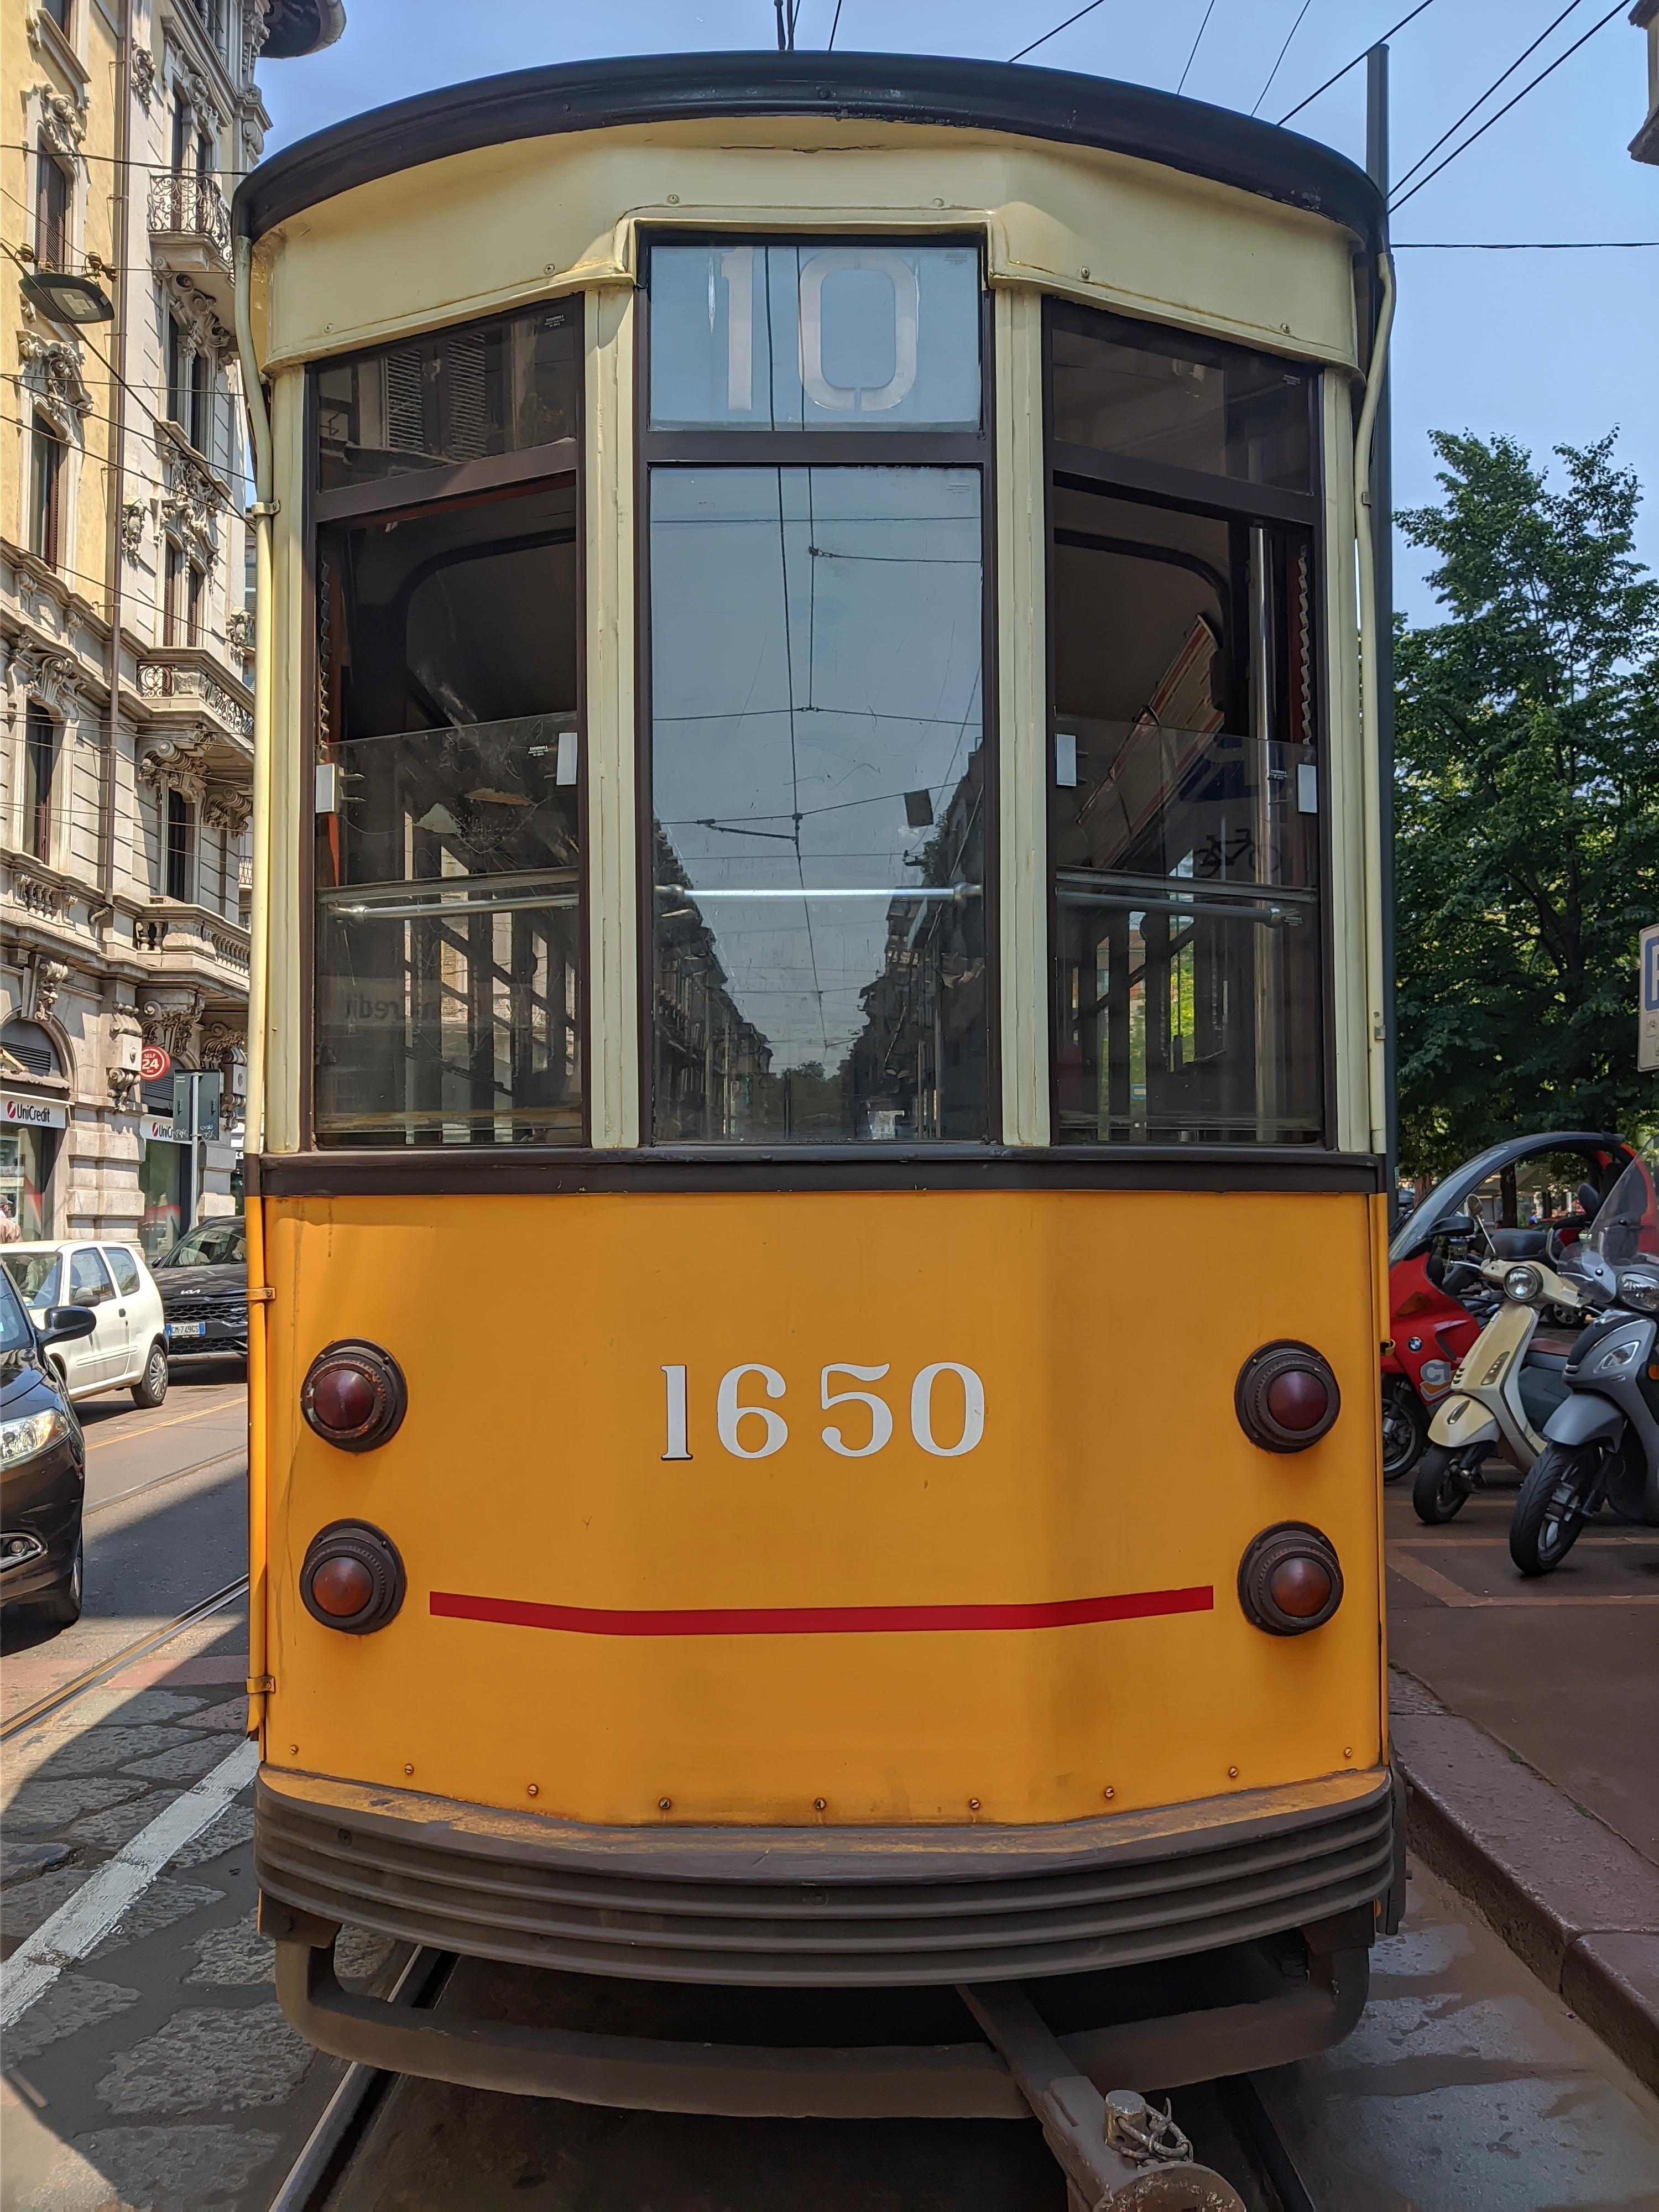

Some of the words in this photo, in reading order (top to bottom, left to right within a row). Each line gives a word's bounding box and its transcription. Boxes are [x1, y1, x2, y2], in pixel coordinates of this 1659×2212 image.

[720, 246, 917, 411] 10
[142, 1058, 159, 1070] 24
[17, 1103, 50, 1123] UniCredit
[660, 1361, 985, 1461] 1650
